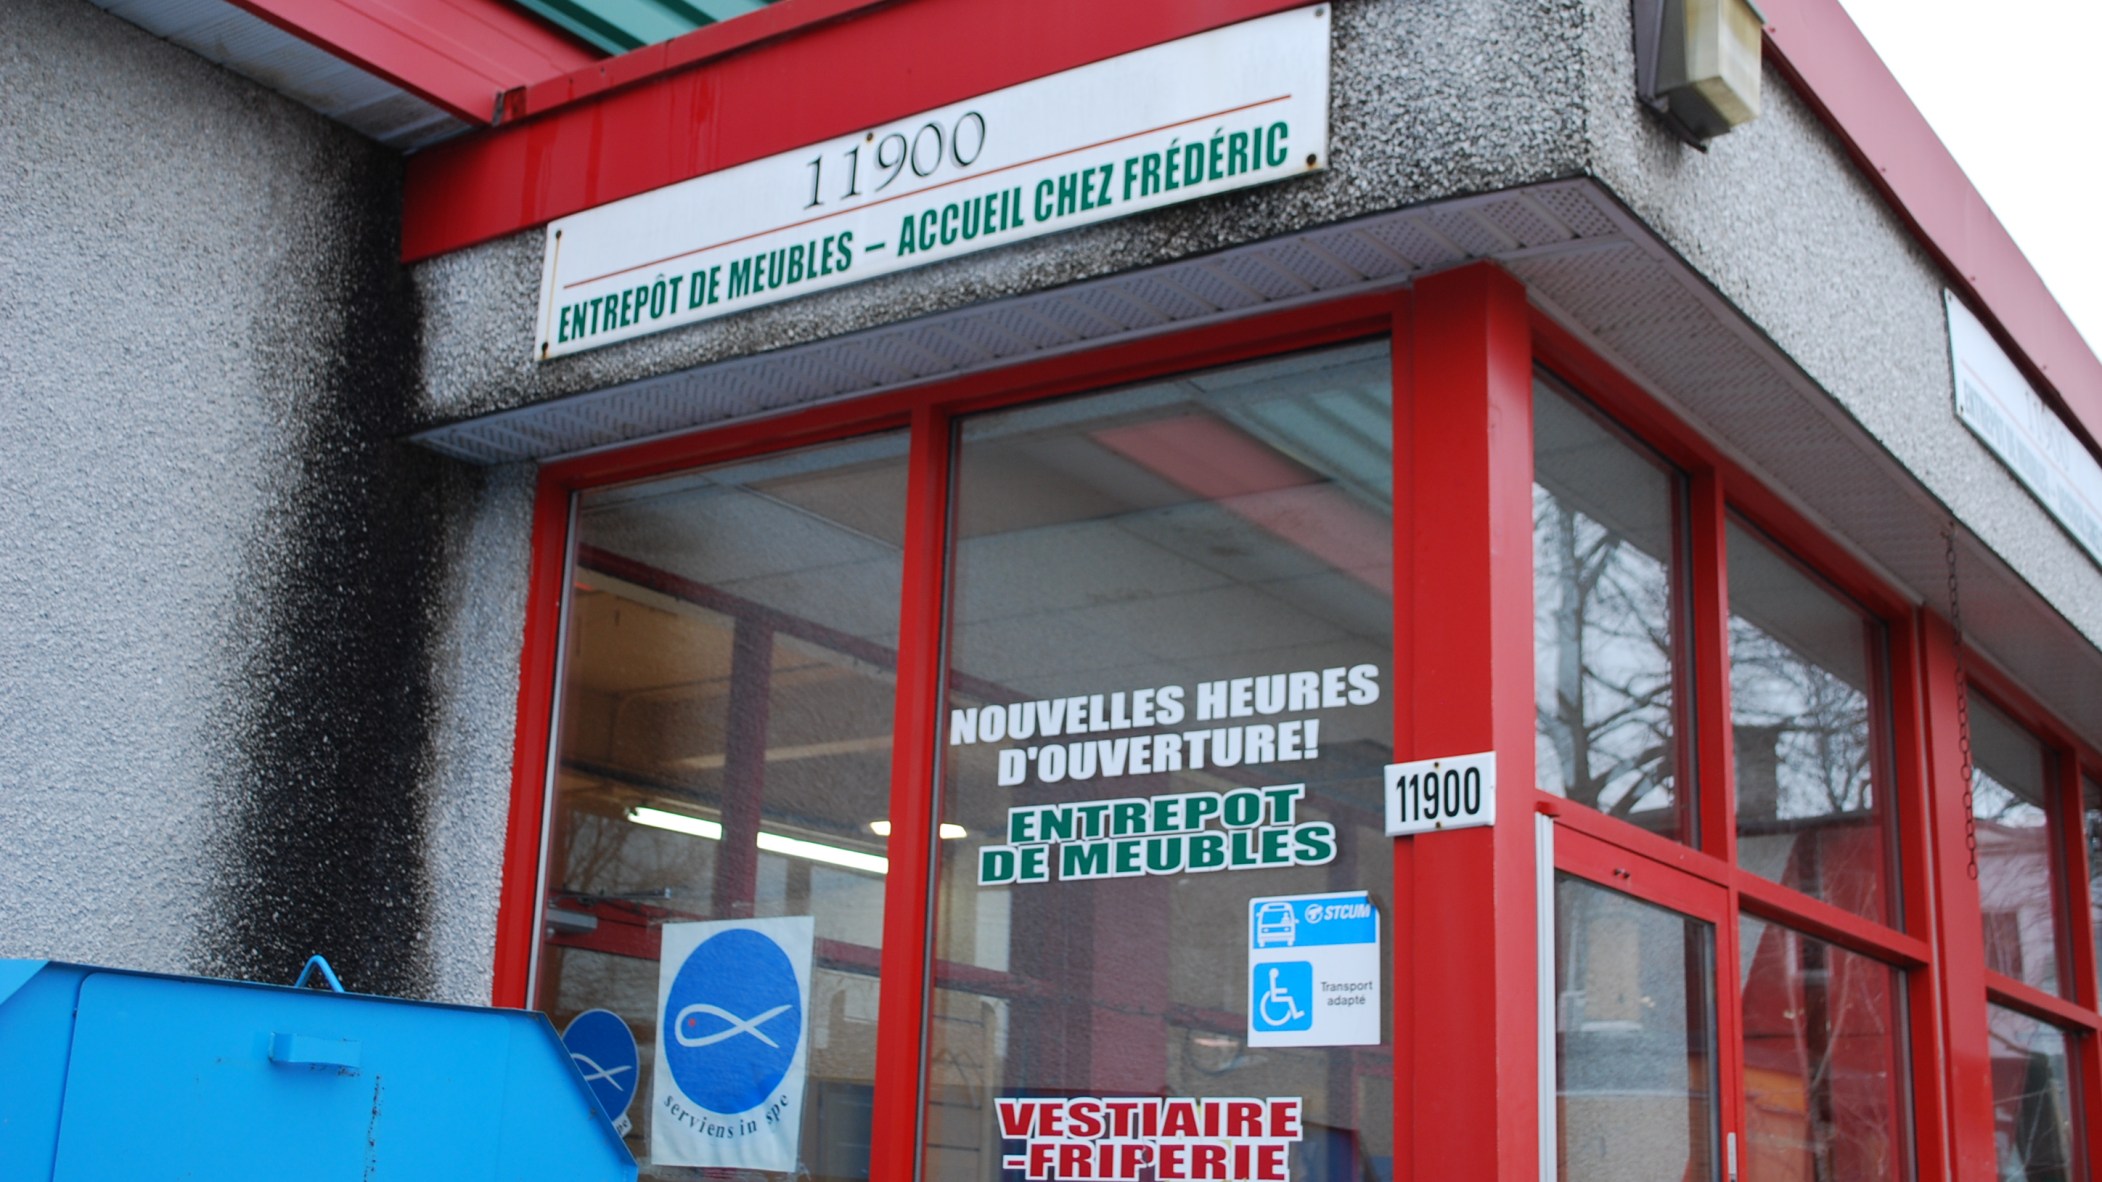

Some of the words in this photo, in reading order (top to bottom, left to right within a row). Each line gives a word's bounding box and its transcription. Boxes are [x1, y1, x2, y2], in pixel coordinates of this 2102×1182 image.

[803, 111, 986, 211] 11900
[558, 273, 683, 344] ENTREPÔT
[688, 265, 721, 310] DE
[727, 231, 854, 300] MEUBLES
[897, 187, 1024, 257] ACCUEIL
[1033, 163, 1114, 223] CHEZ
[1123, 121, 1289, 201] FRÉDÉRIC
[950, 685, 1185, 745] NOUVELLES
[1196, 664, 1380, 722] HEURES
[998, 719, 1320, 786] D'OUVERTURE!
[1008, 784, 1305, 844] ENTREPOT
[1395, 765, 1482, 823] 11900
[978, 843, 1049, 885] DE
[1059, 822, 1337, 881] MEUBLES
[1324, 903, 1372, 921] STCUM
[1320, 981, 1374, 993] Transport
[1327, 994, 1367, 1007] adapté
[664, 1095, 734, 1139] serviens
[740, 1119, 758, 1136] in
[994, 1097, 1303, 1141] VESTIAIRE
